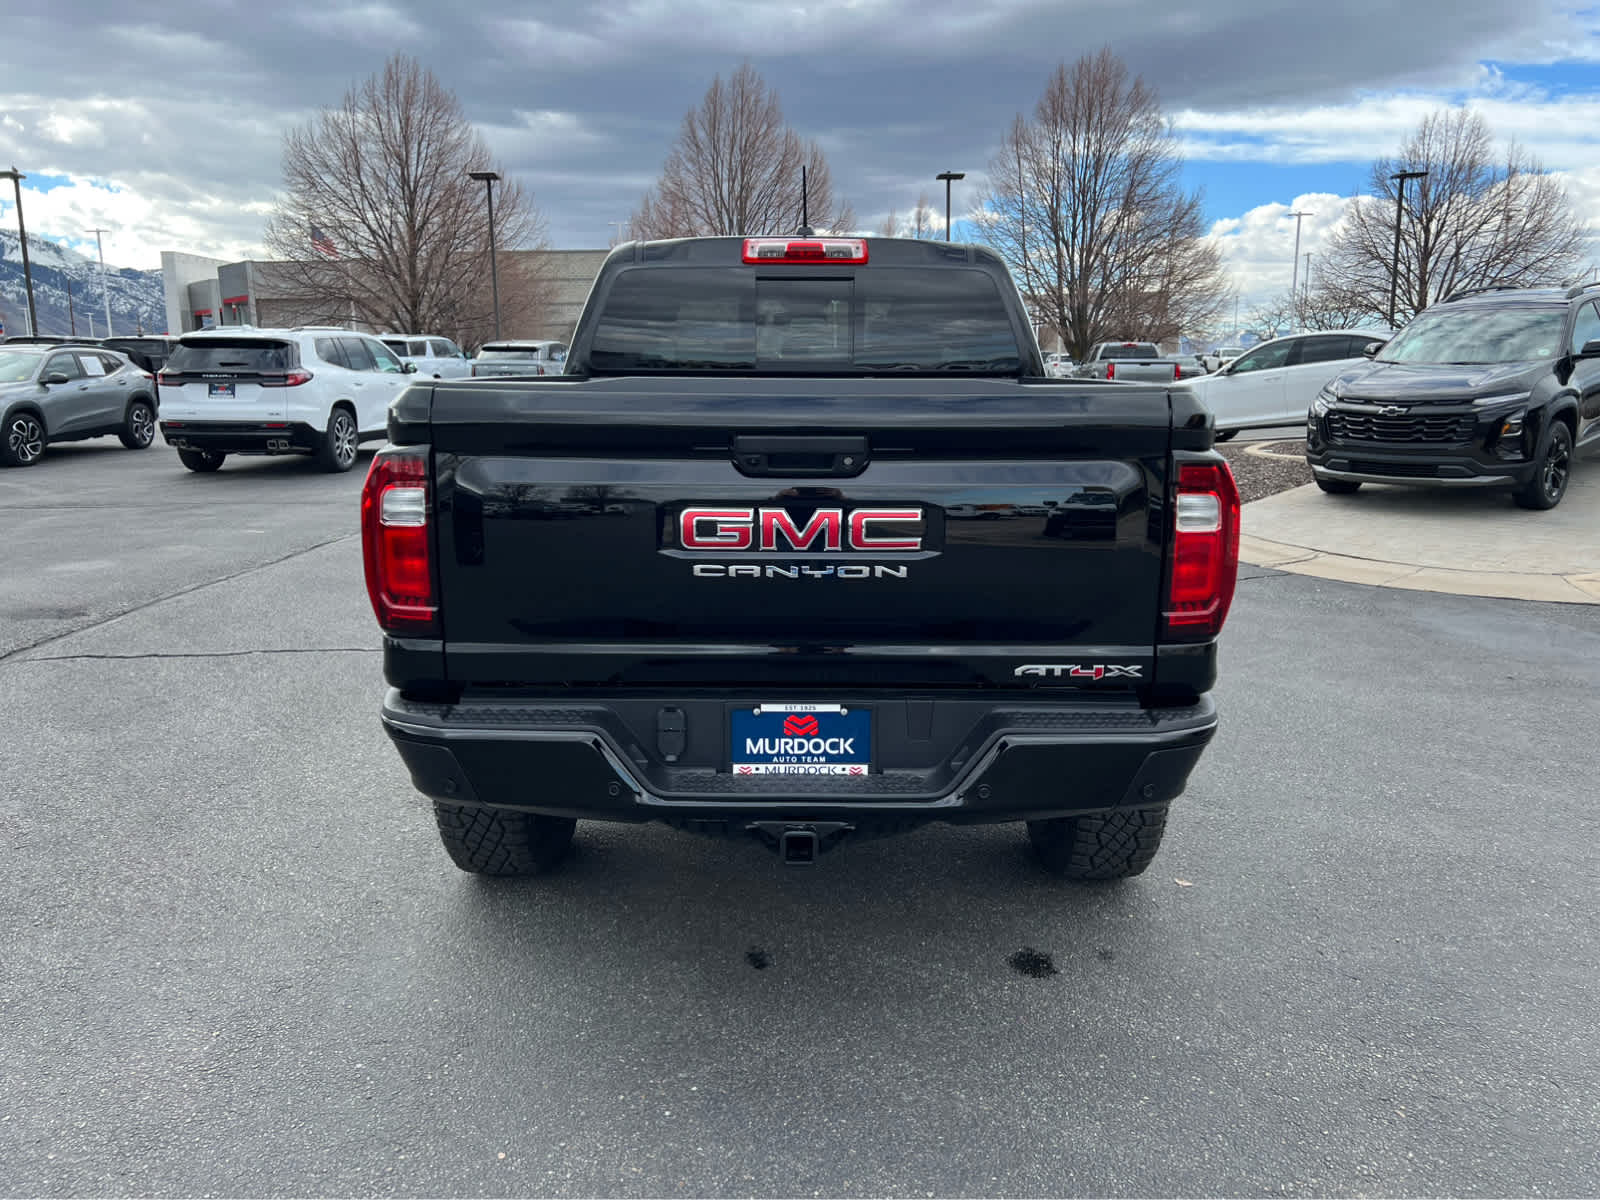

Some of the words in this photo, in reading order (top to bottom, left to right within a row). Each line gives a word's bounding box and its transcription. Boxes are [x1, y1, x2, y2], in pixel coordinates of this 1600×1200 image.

[680, 508, 922, 551] GMC
[693, 564, 908, 578] CANYON
[1014, 664, 1143, 681] AT4X
[745, 737, 855, 755] MURDOCK
[764, 766, 837, 775] MURDOCK
